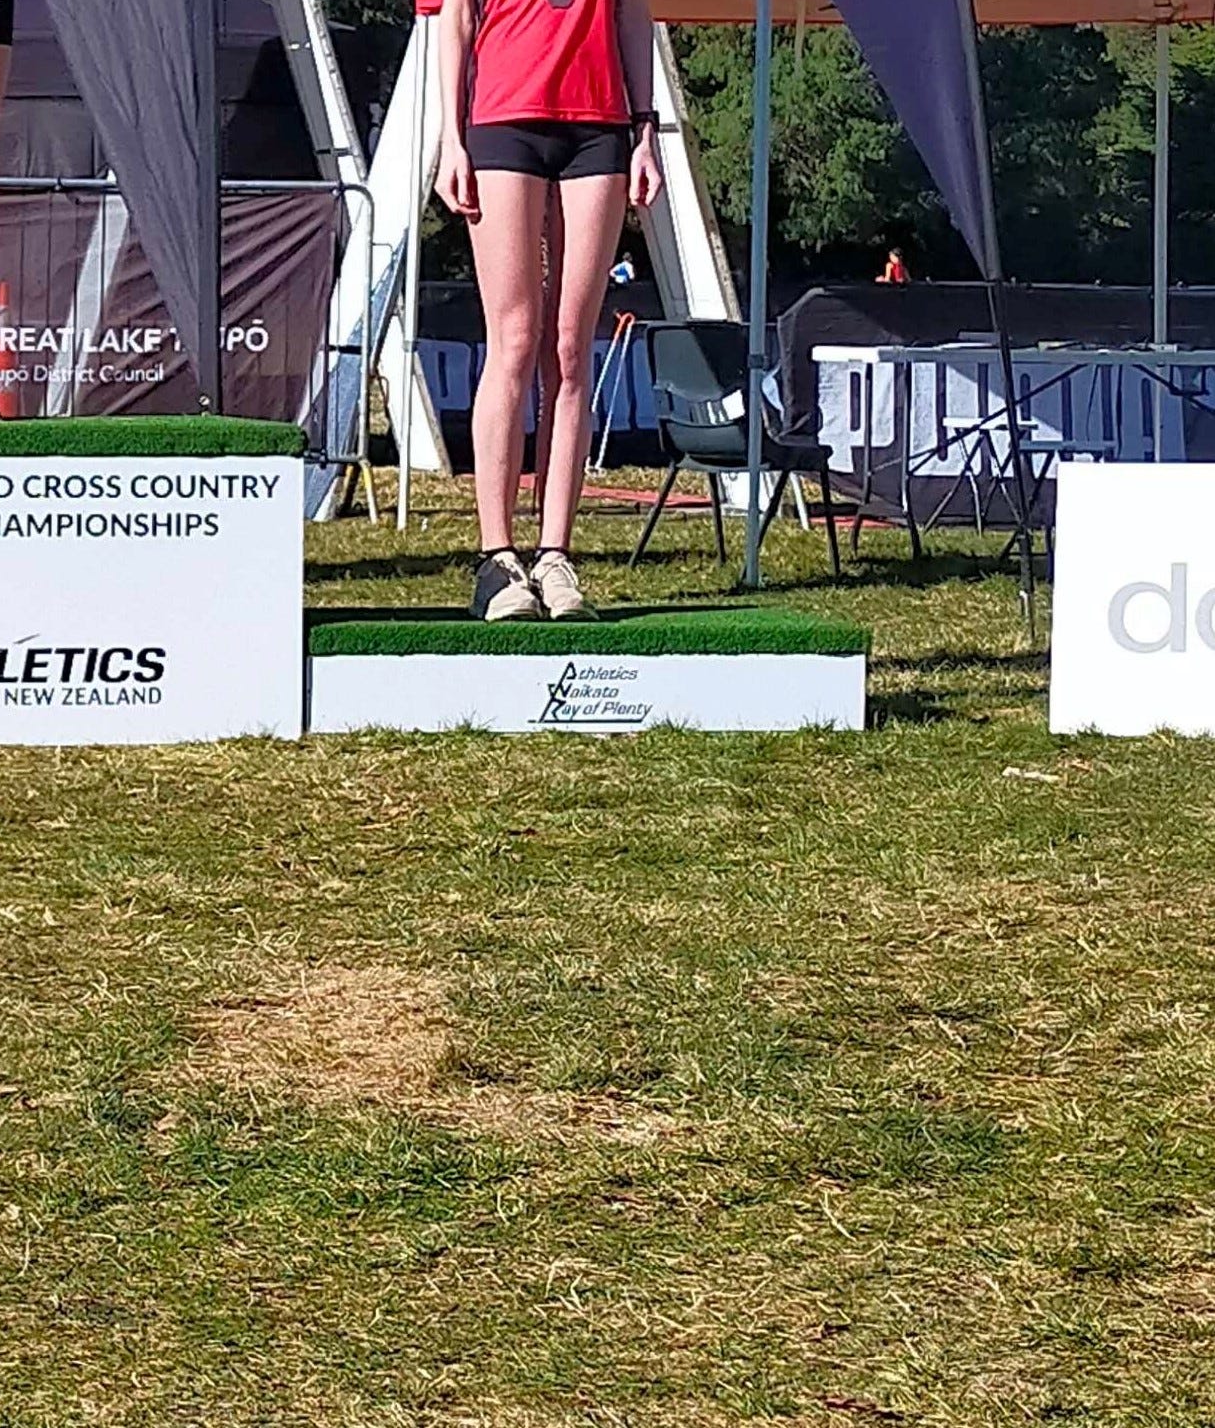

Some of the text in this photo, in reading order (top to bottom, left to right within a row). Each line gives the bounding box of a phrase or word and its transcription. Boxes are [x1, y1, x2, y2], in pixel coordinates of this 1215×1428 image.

[83, 328, 162, 353] LAKE
[99, 363, 164, 383] Council
[22, 475, 121, 499] CROSS
[129, 475, 280, 499] COUNTRY
[4, 686, 163, 707] NEW ZEALAND
[583, 701, 600, 715] of
[602, 700, 652, 719] Plenty
